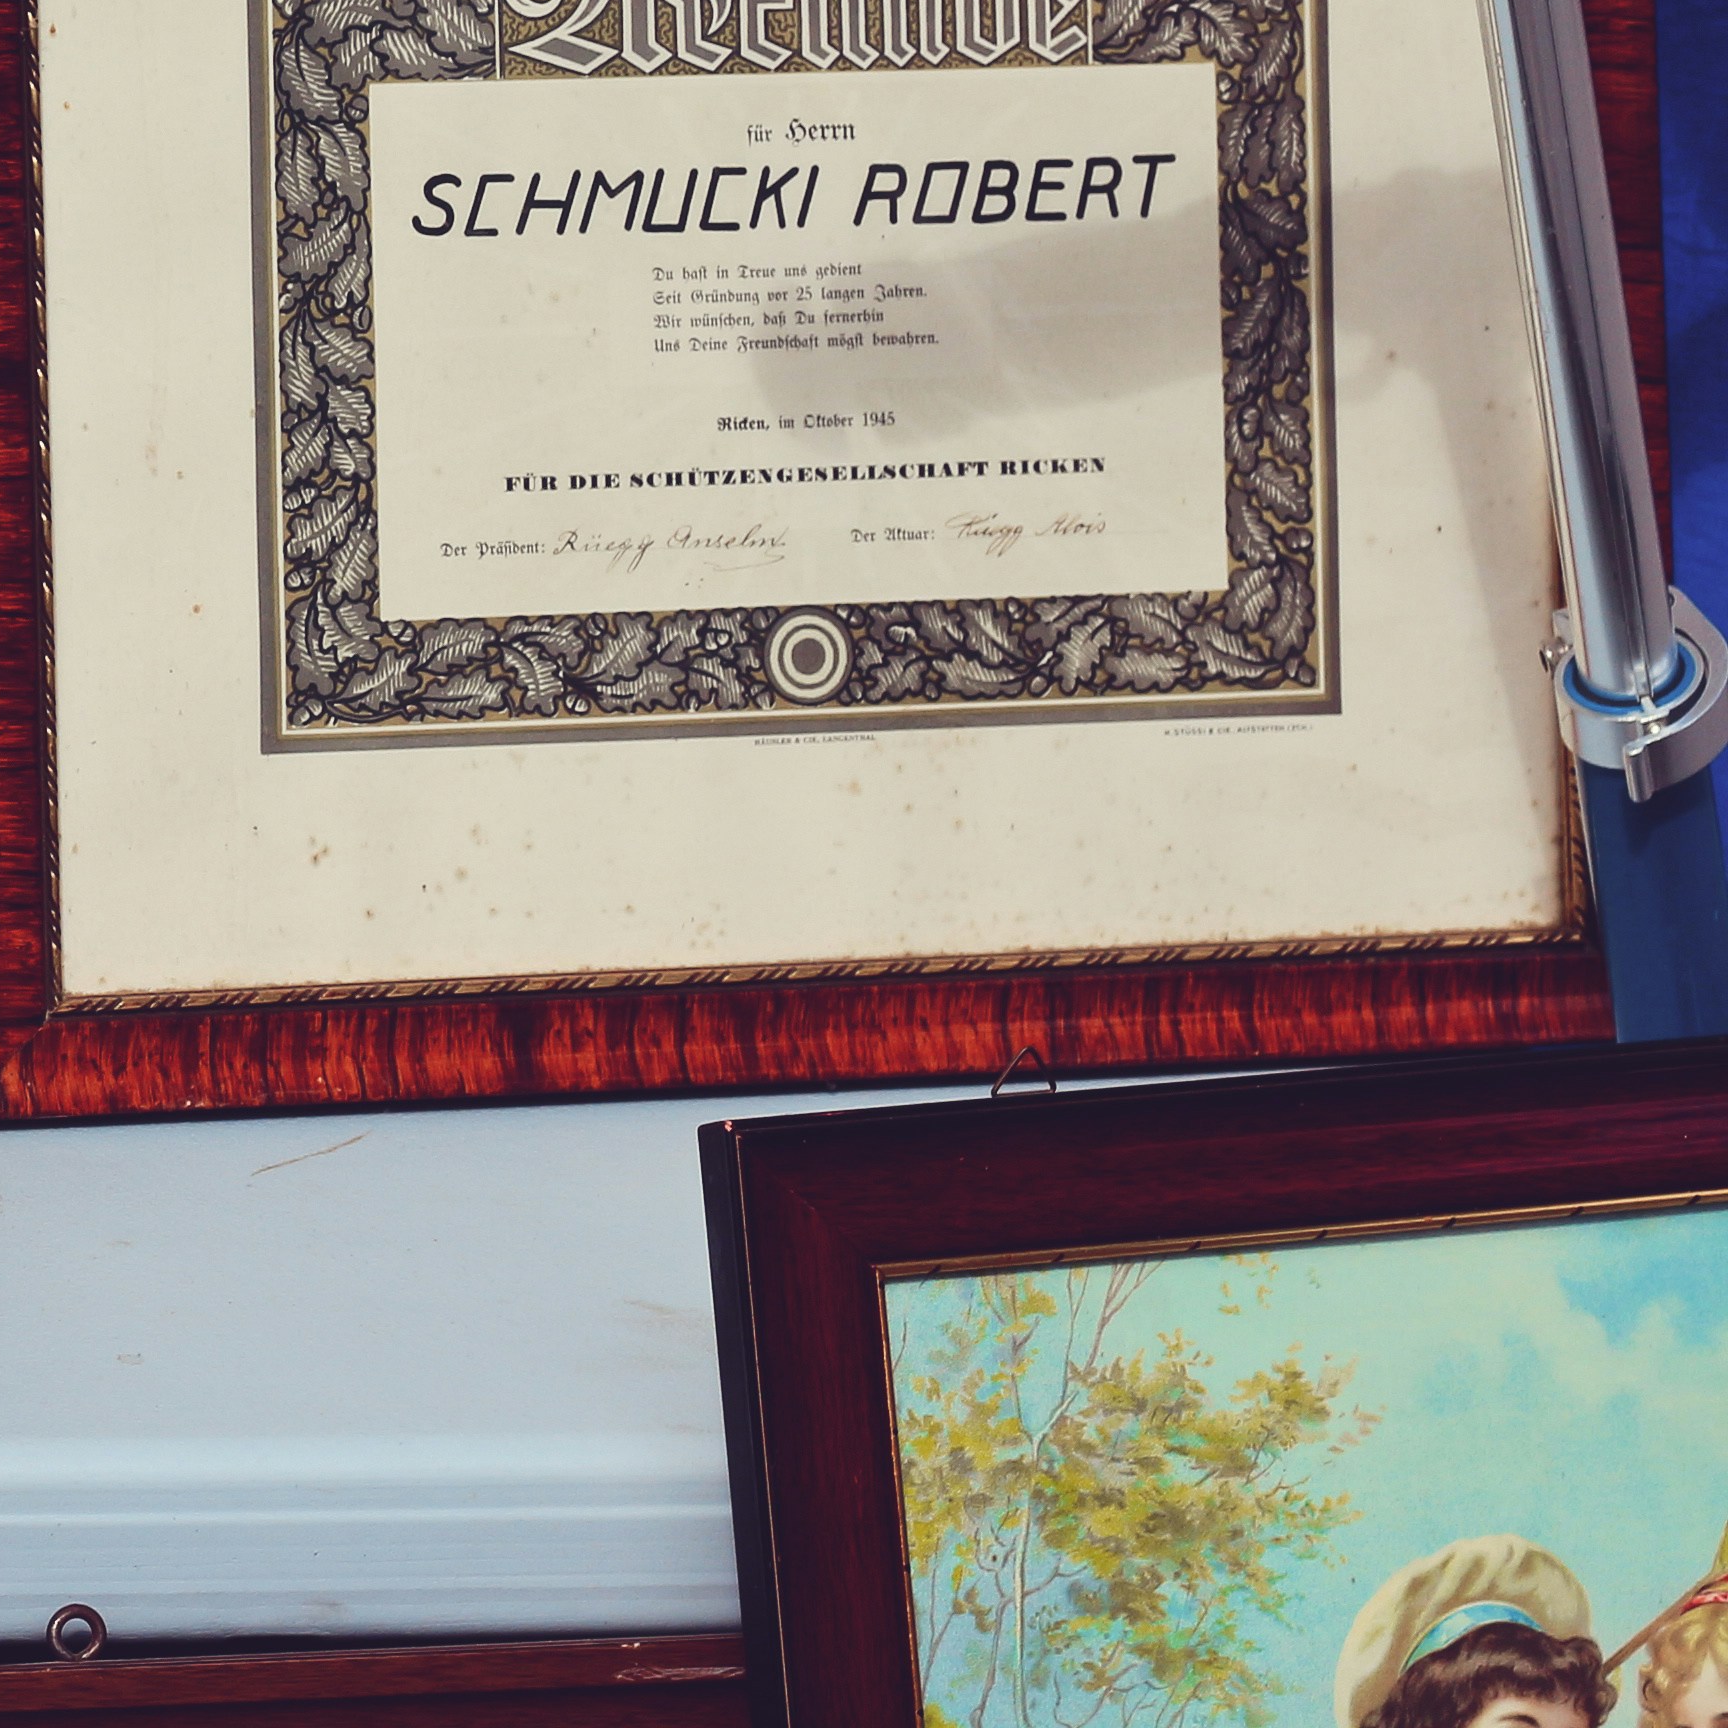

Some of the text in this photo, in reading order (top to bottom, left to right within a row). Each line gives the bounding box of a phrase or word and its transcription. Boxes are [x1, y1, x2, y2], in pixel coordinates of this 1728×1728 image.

[746, 118, 856, 146] für Herrn
[411, 154, 1177, 238] SCHMUCKI ROBERT
[652, 266, 674, 281] Du
[716, 265, 729, 279] in
[737, 264, 776, 279] Treue
[784, 264, 808, 277] uns
[815, 262, 862, 280] gedient
[653, 283, 927, 306] Seit Gründung vor 25 langen Jahren.
[654, 315, 682, 328] Wir
[690, 313, 755, 328] wünschen,
[794, 310, 815, 325] Du
[824, 308, 884, 326] fernerhin
[654, 338, 680, 353] Uns
[689, 337, 728, 352] Deine
[737, 335, 818, 352] Freundschaft
[872, 331, 939, 348] bewahren.
[717, 411, 896, 432] Ricken, im Oktober 1945
[504, 457, 1106, 492] FÜR DIE SCHÜTZENGESELLSCHAFT RICKEN
[851, 527, 935, 543] Der Aktuar:
[441, 541, 545, 559] Der Präsident:
